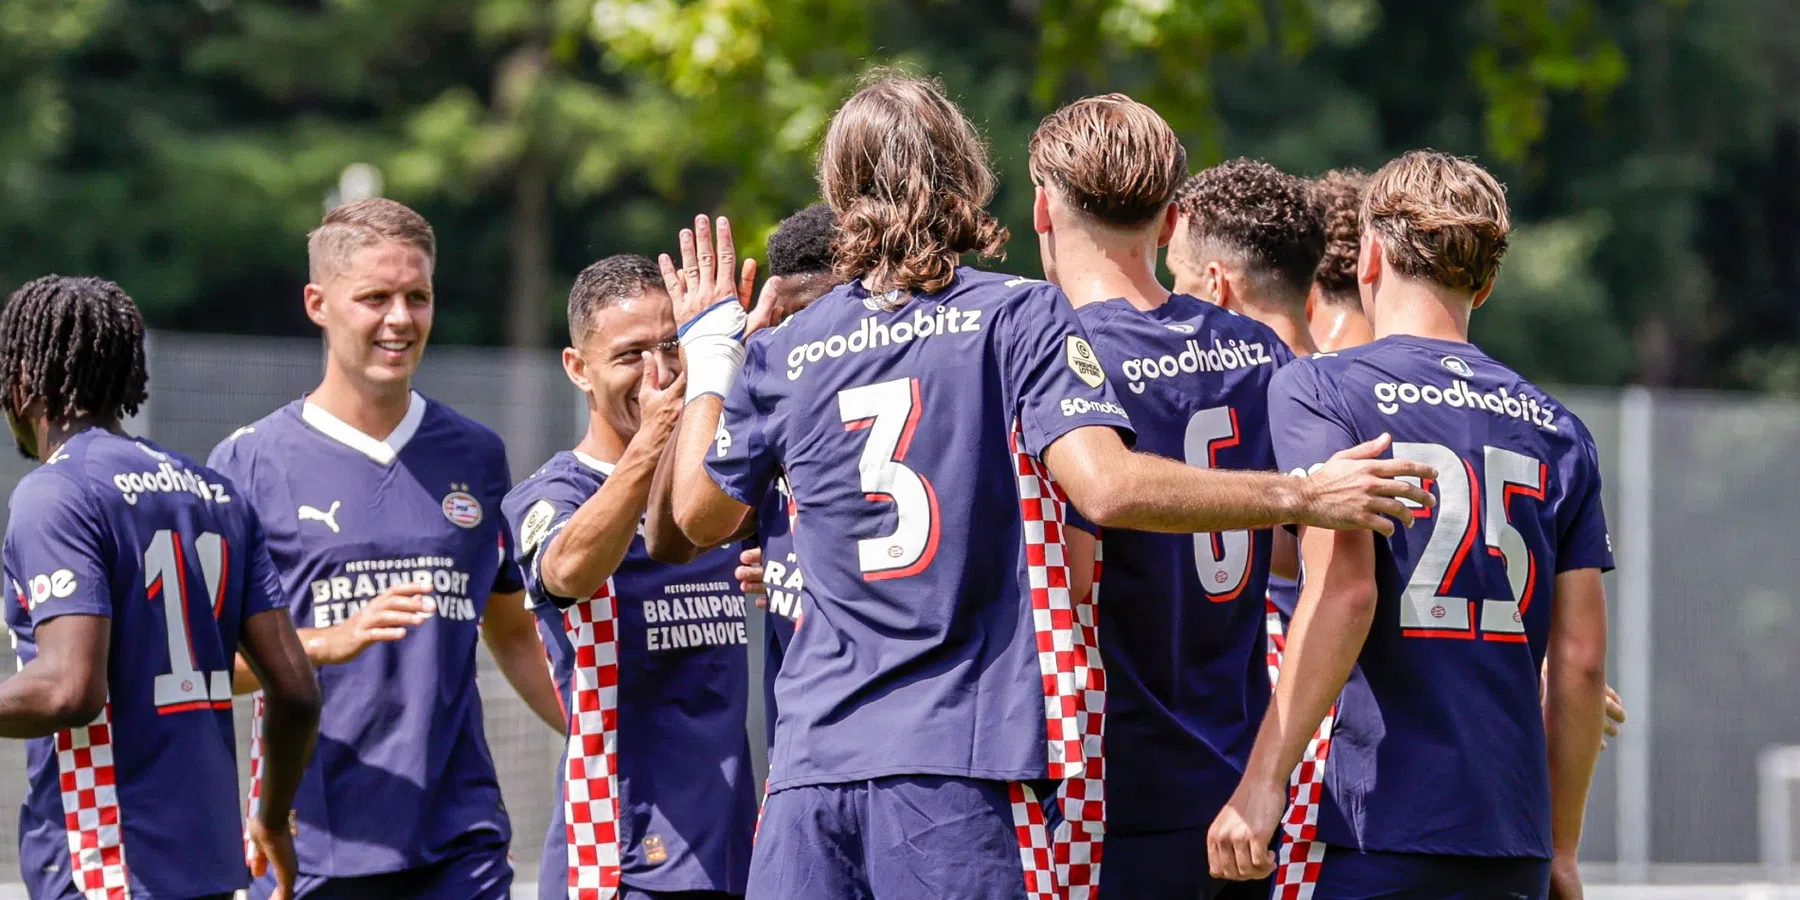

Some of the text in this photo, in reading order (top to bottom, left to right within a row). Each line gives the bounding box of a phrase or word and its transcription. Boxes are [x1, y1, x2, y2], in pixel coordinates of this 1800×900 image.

[787, 305, 982, 381] goodhabitz
[1122, 339, 1272, 395] goodhabitz
[1374, 380, 1558, 432] goodhabitz
[837, 376, 941, 581] 3
[1184, 405, 1255, 602] 6
[345, 556, 454, 573] METROPOOLREGIO
[1391, 441, 1547, 643] 25
[311, 569, 470, 603] BRAINPORT
[313, 594, 476, 628] EINOVEN
[643, 595, 748, 623] BRAINPORT
[646, 622, 749, 651] EINDHOVE
